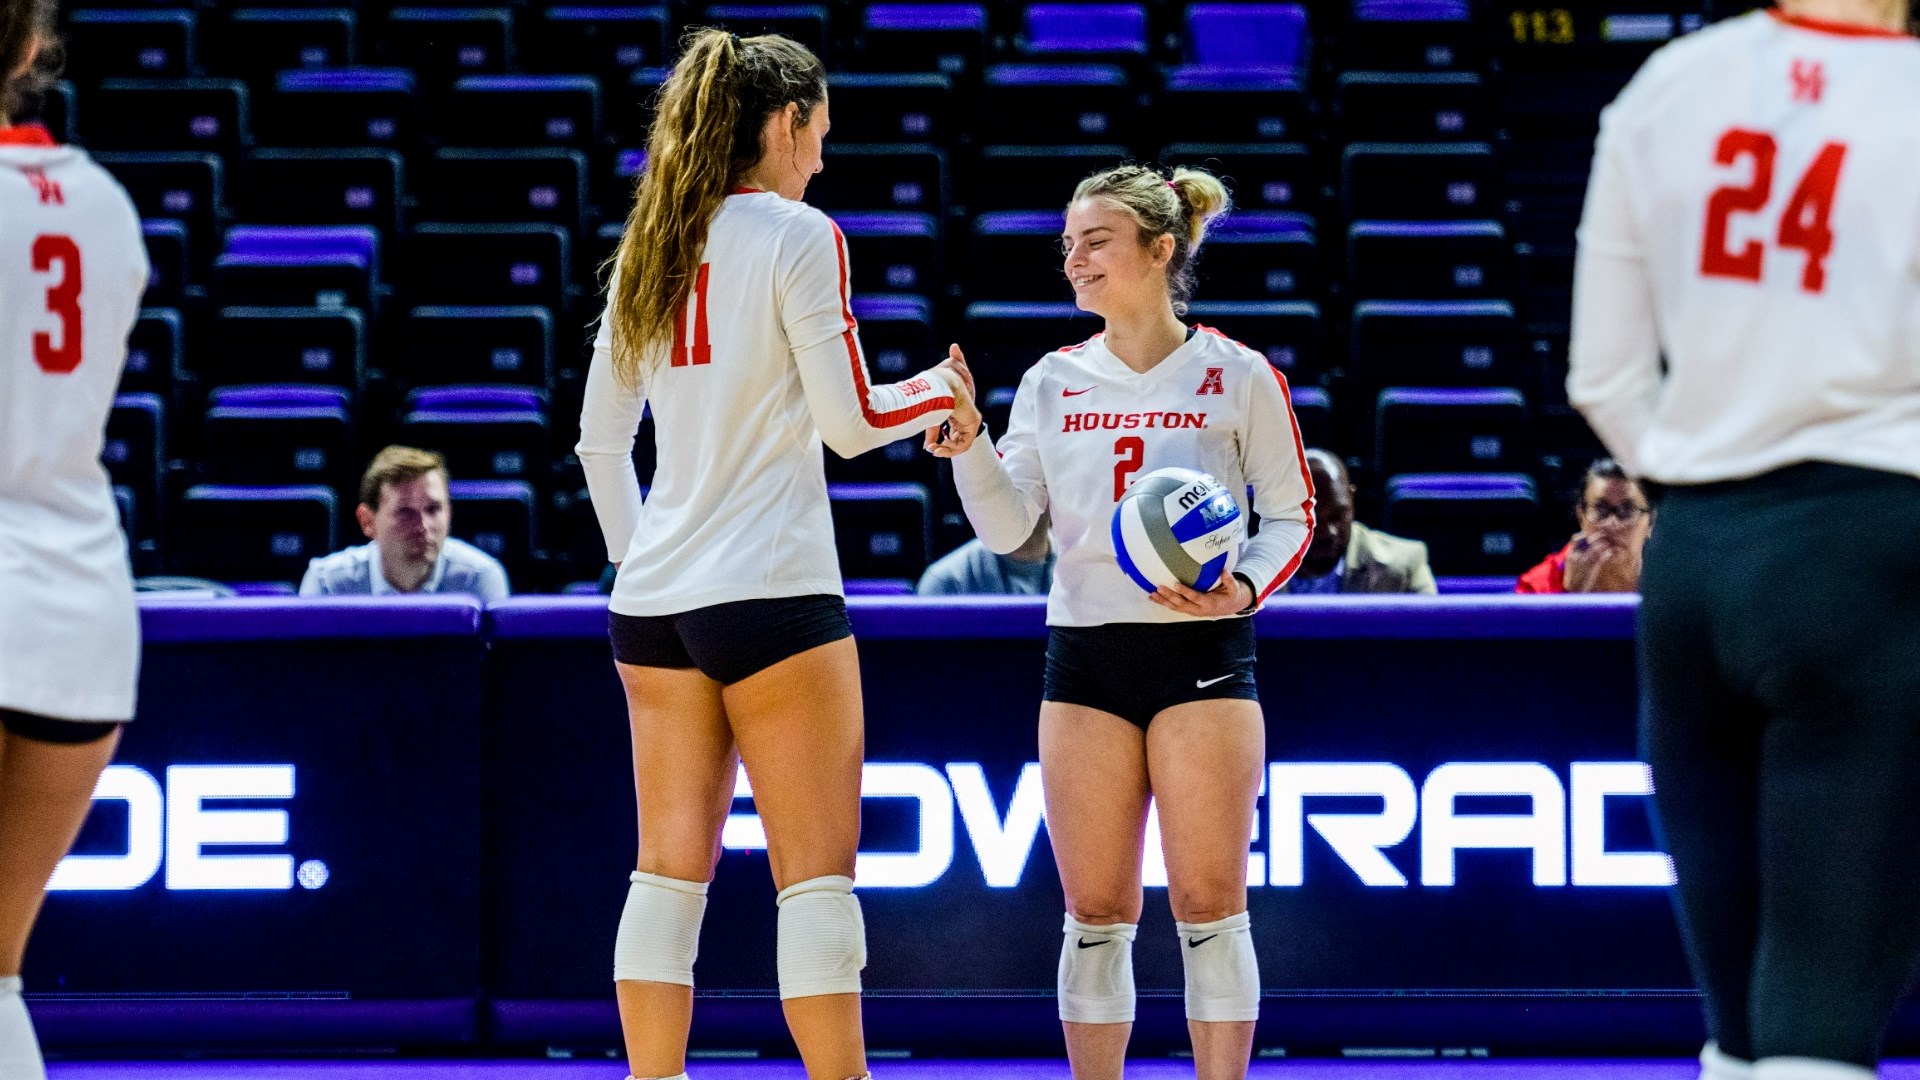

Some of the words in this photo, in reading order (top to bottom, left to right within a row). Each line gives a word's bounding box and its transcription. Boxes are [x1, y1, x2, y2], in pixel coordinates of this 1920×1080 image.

[1509, 10, 1574, 44] 113
[1700, 124, 1847, 293] 24
[31, 234, 83, 374] 3
[671, 262, 711, 367] 11
[1196, 368, 1224, 395] A
[1113, 436, 1145, 502] 2
